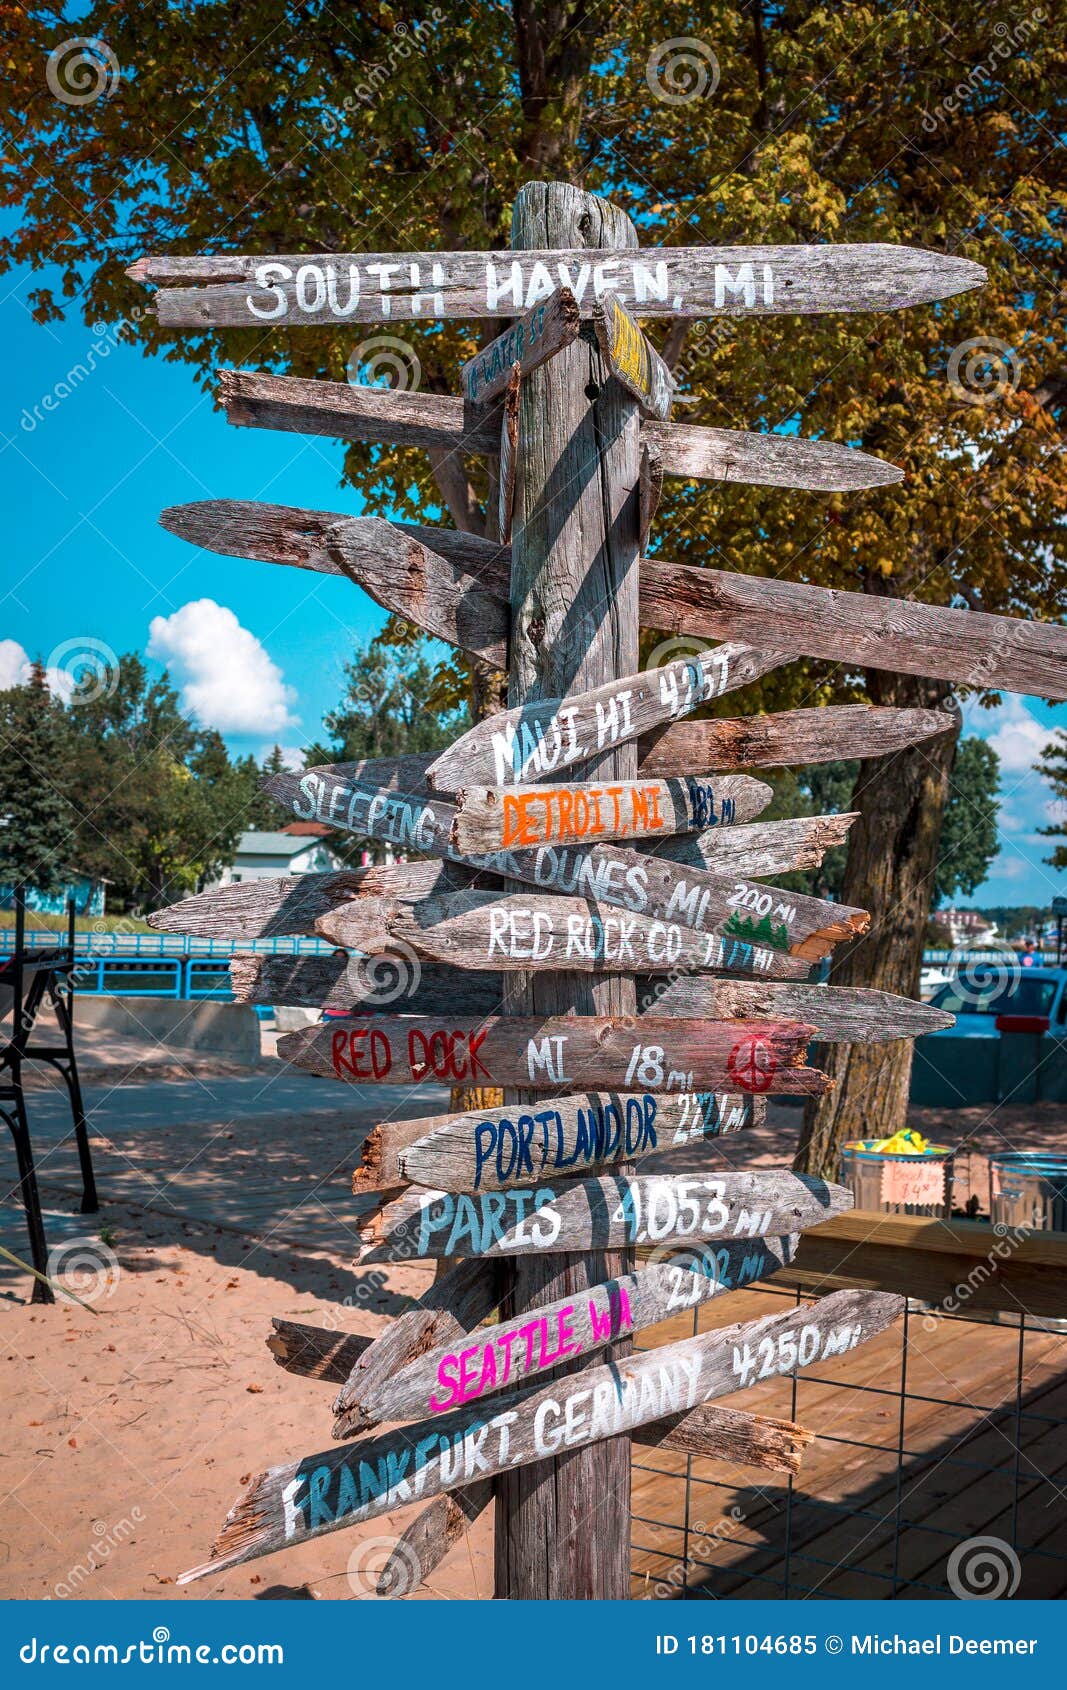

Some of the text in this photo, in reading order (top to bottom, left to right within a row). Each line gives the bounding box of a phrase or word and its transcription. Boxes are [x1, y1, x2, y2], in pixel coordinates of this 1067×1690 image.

[246, 262, 445, 320] SOUTH
[714, 262, 774, 309] MI
[482, 324, 524, 385] WATER
[530, 307, 545, 345] ST
[595, 690, 636, 750] HI
[721, 797, 737, 825] MI
[292, 772, 436, 850] SLEEPING
[665, 880, 711, 931] MI
[726, 883, 773, 916] 200
[773, 902, 797, 924] MI
[487, 907, 554, 961] RED
[564, 914, 637, 960] ROCK
[647, 921, 682, 963] CO
[752, 946, 775, 972] MI
[332, 1028, 393, 1080] RED
[408, 1026, 493, 1082] DOCK
[527, 1035, 574, 1083] MI
[624, 1043, 665, 1087] 18
[417, 1189, 561, 1257] PARIS
[733, 1208, 774, 1237] MI
[429, 1304, 583, 1412] SEATTLE,
[588, 1287, 633, 1344] WA
[737, 1252, 765, 1284] MI
[533, 1352, 713, 1452] GERMANY,
